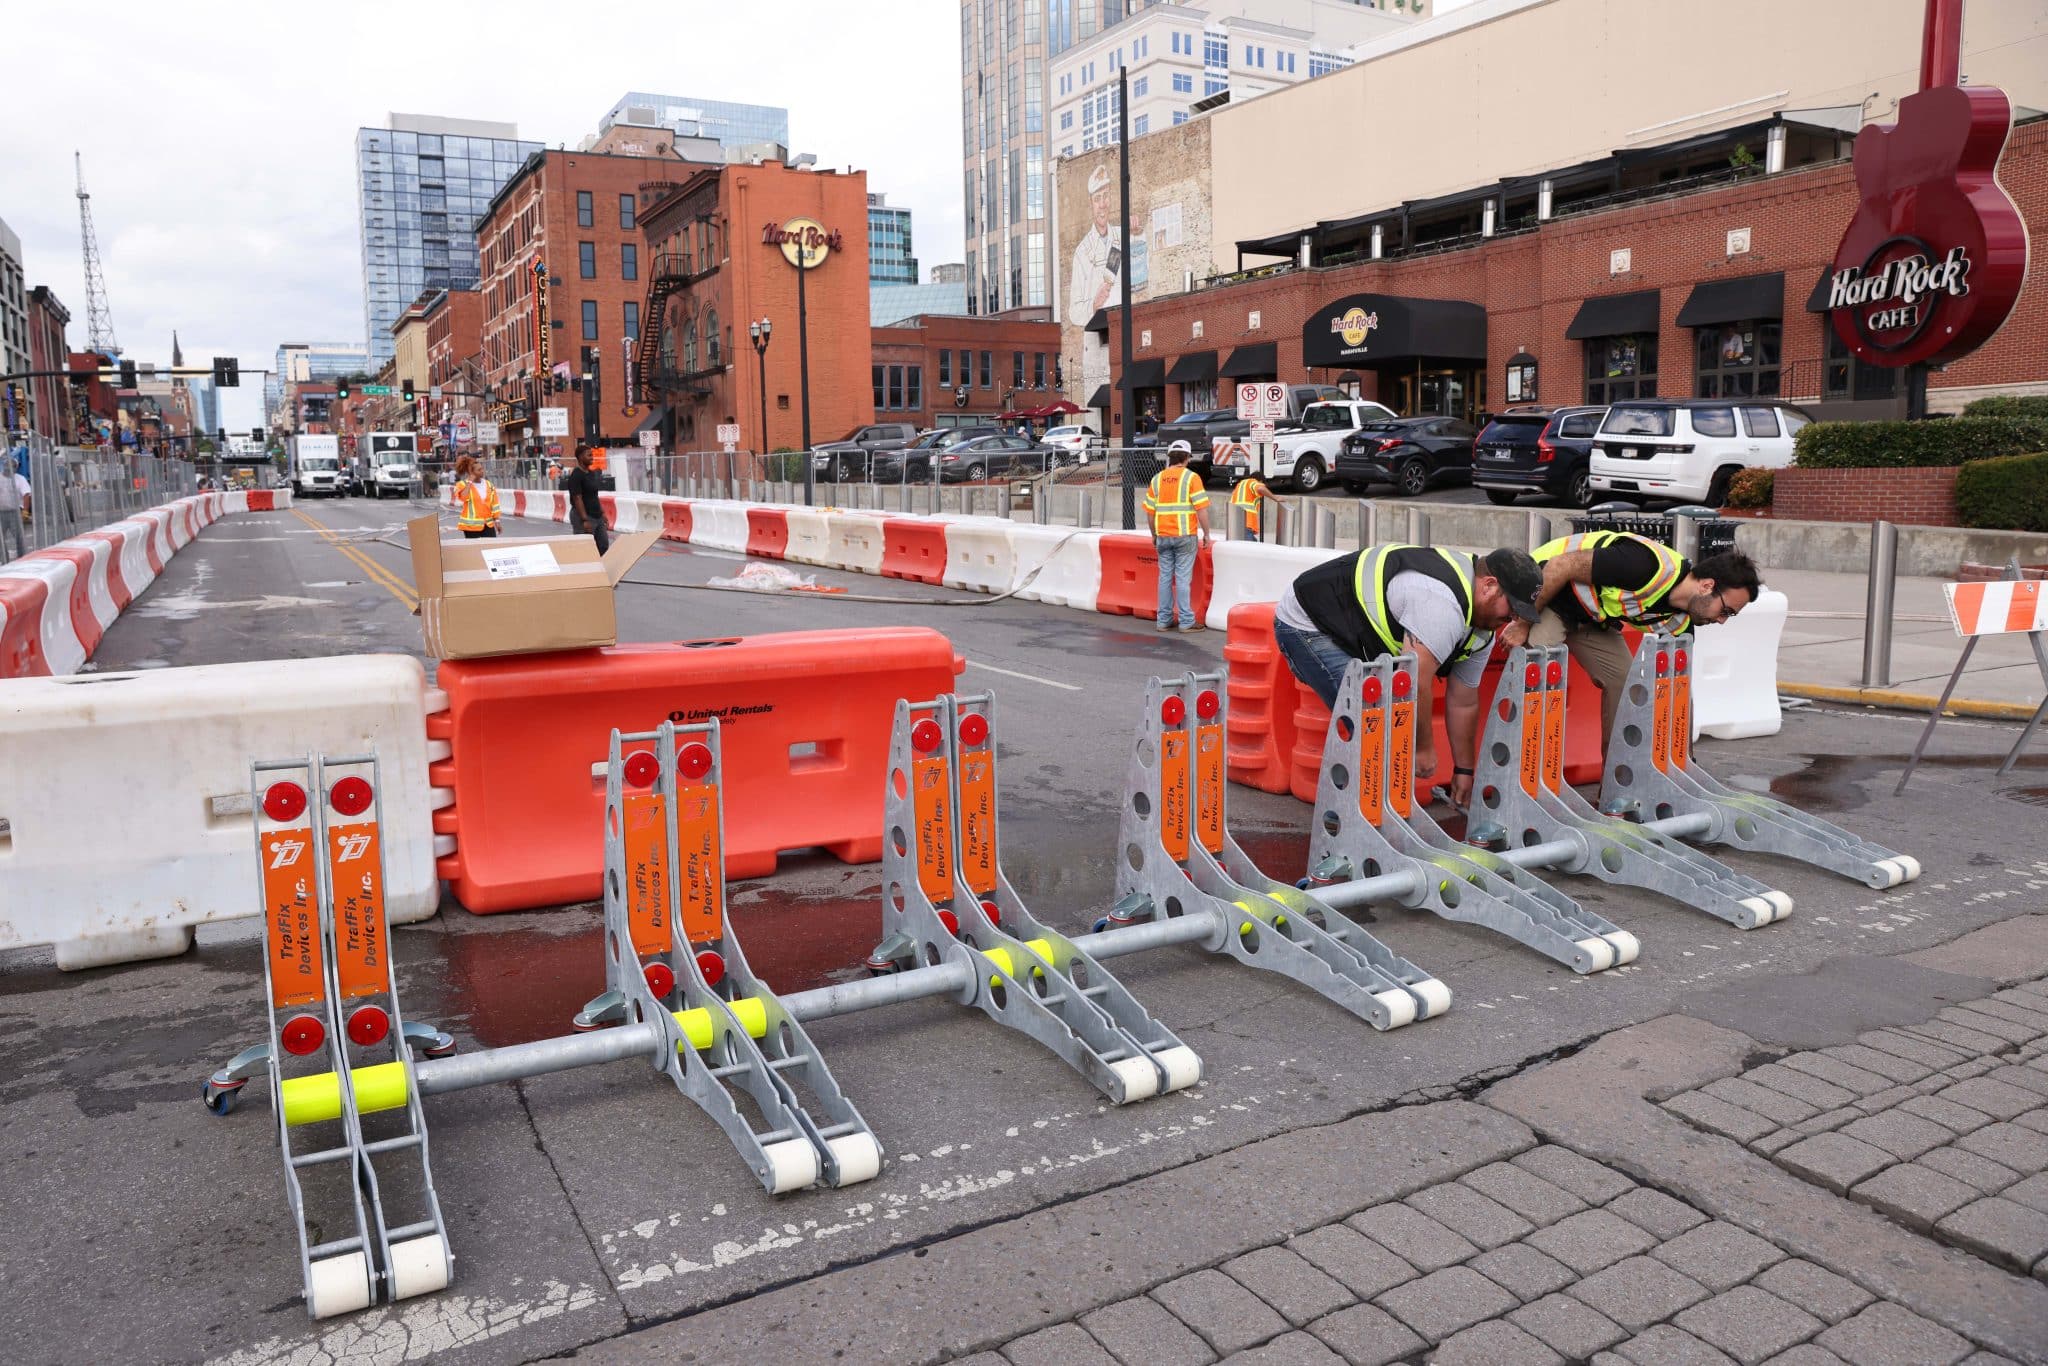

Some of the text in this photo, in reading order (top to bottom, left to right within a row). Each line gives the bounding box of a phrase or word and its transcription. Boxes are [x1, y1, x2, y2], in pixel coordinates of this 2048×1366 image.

[622, 142, 645, 153] HELL
[761, 223, 842, 252] Hard Rock
[1828, 246, 1971, 308] Hard Rock
[1331, 311, 1377, 332] Hard Rock
[1868, 306, 1917, 330] CAFE
[1341, 346, 1368, 355] NASHVILLE
[687, 704, 773, 719] United Rentals
[1401, 734, 1409, 755] Inc.
[979, 791, 987, 815] Inc.
[1176, 767, 1184, 840] Devices Inc.
[1210, 760, 1218, 832] Devices Inc.
[923, 819, 933, 865] TrafFix
[936, 826, 945, 878] Devices
[294, 878, 306, 908] Inc.
[688, 852, 699, 902] TrafFix
[701, 830, 713, 916] Devices Inc.
[345, 896, 360, 952] TrafFix
[360, 871, 377, 967] Devices Inc.
[650, 870, 662, 928] Devices
[278, 903, 294, 960] TrafFix
[297, 912, 312, 975] Devices
